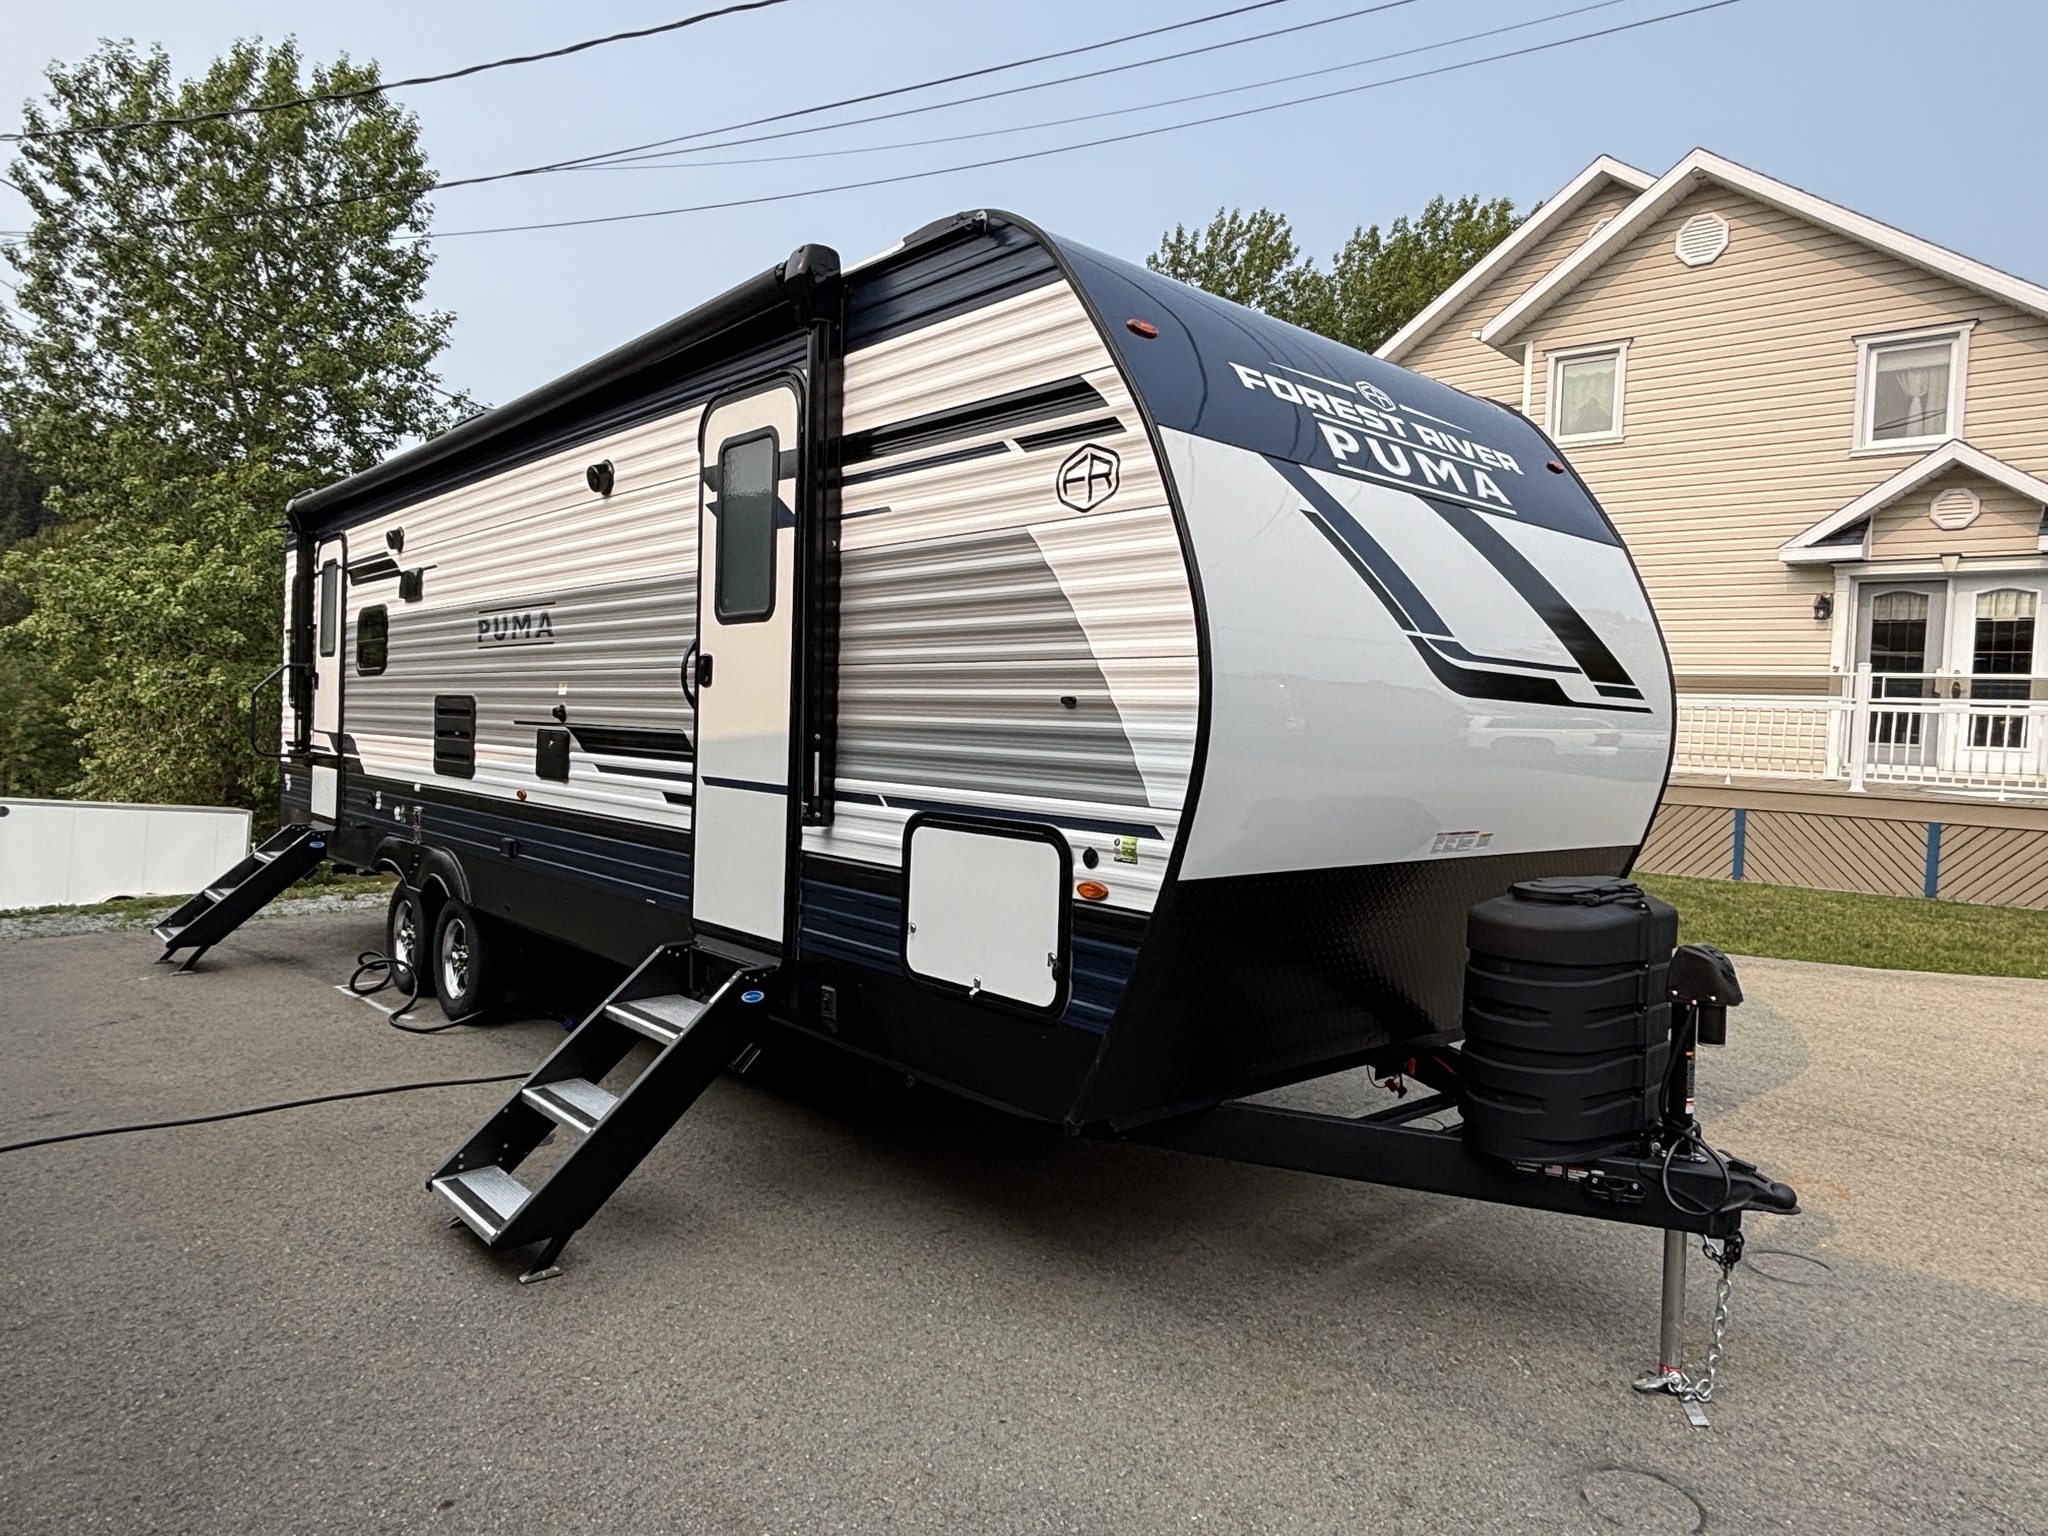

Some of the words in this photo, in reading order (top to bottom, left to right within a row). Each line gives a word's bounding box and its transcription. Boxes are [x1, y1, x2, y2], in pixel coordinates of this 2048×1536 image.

[1228, 361, 1405, 438] FOREST
[1410, 421, 1525, 475] RIVER
[1060, 450, 1116, 504] FR
[1318, 421, 1512, 506] PUMA
[477, 611, 555, 643] PUMA
